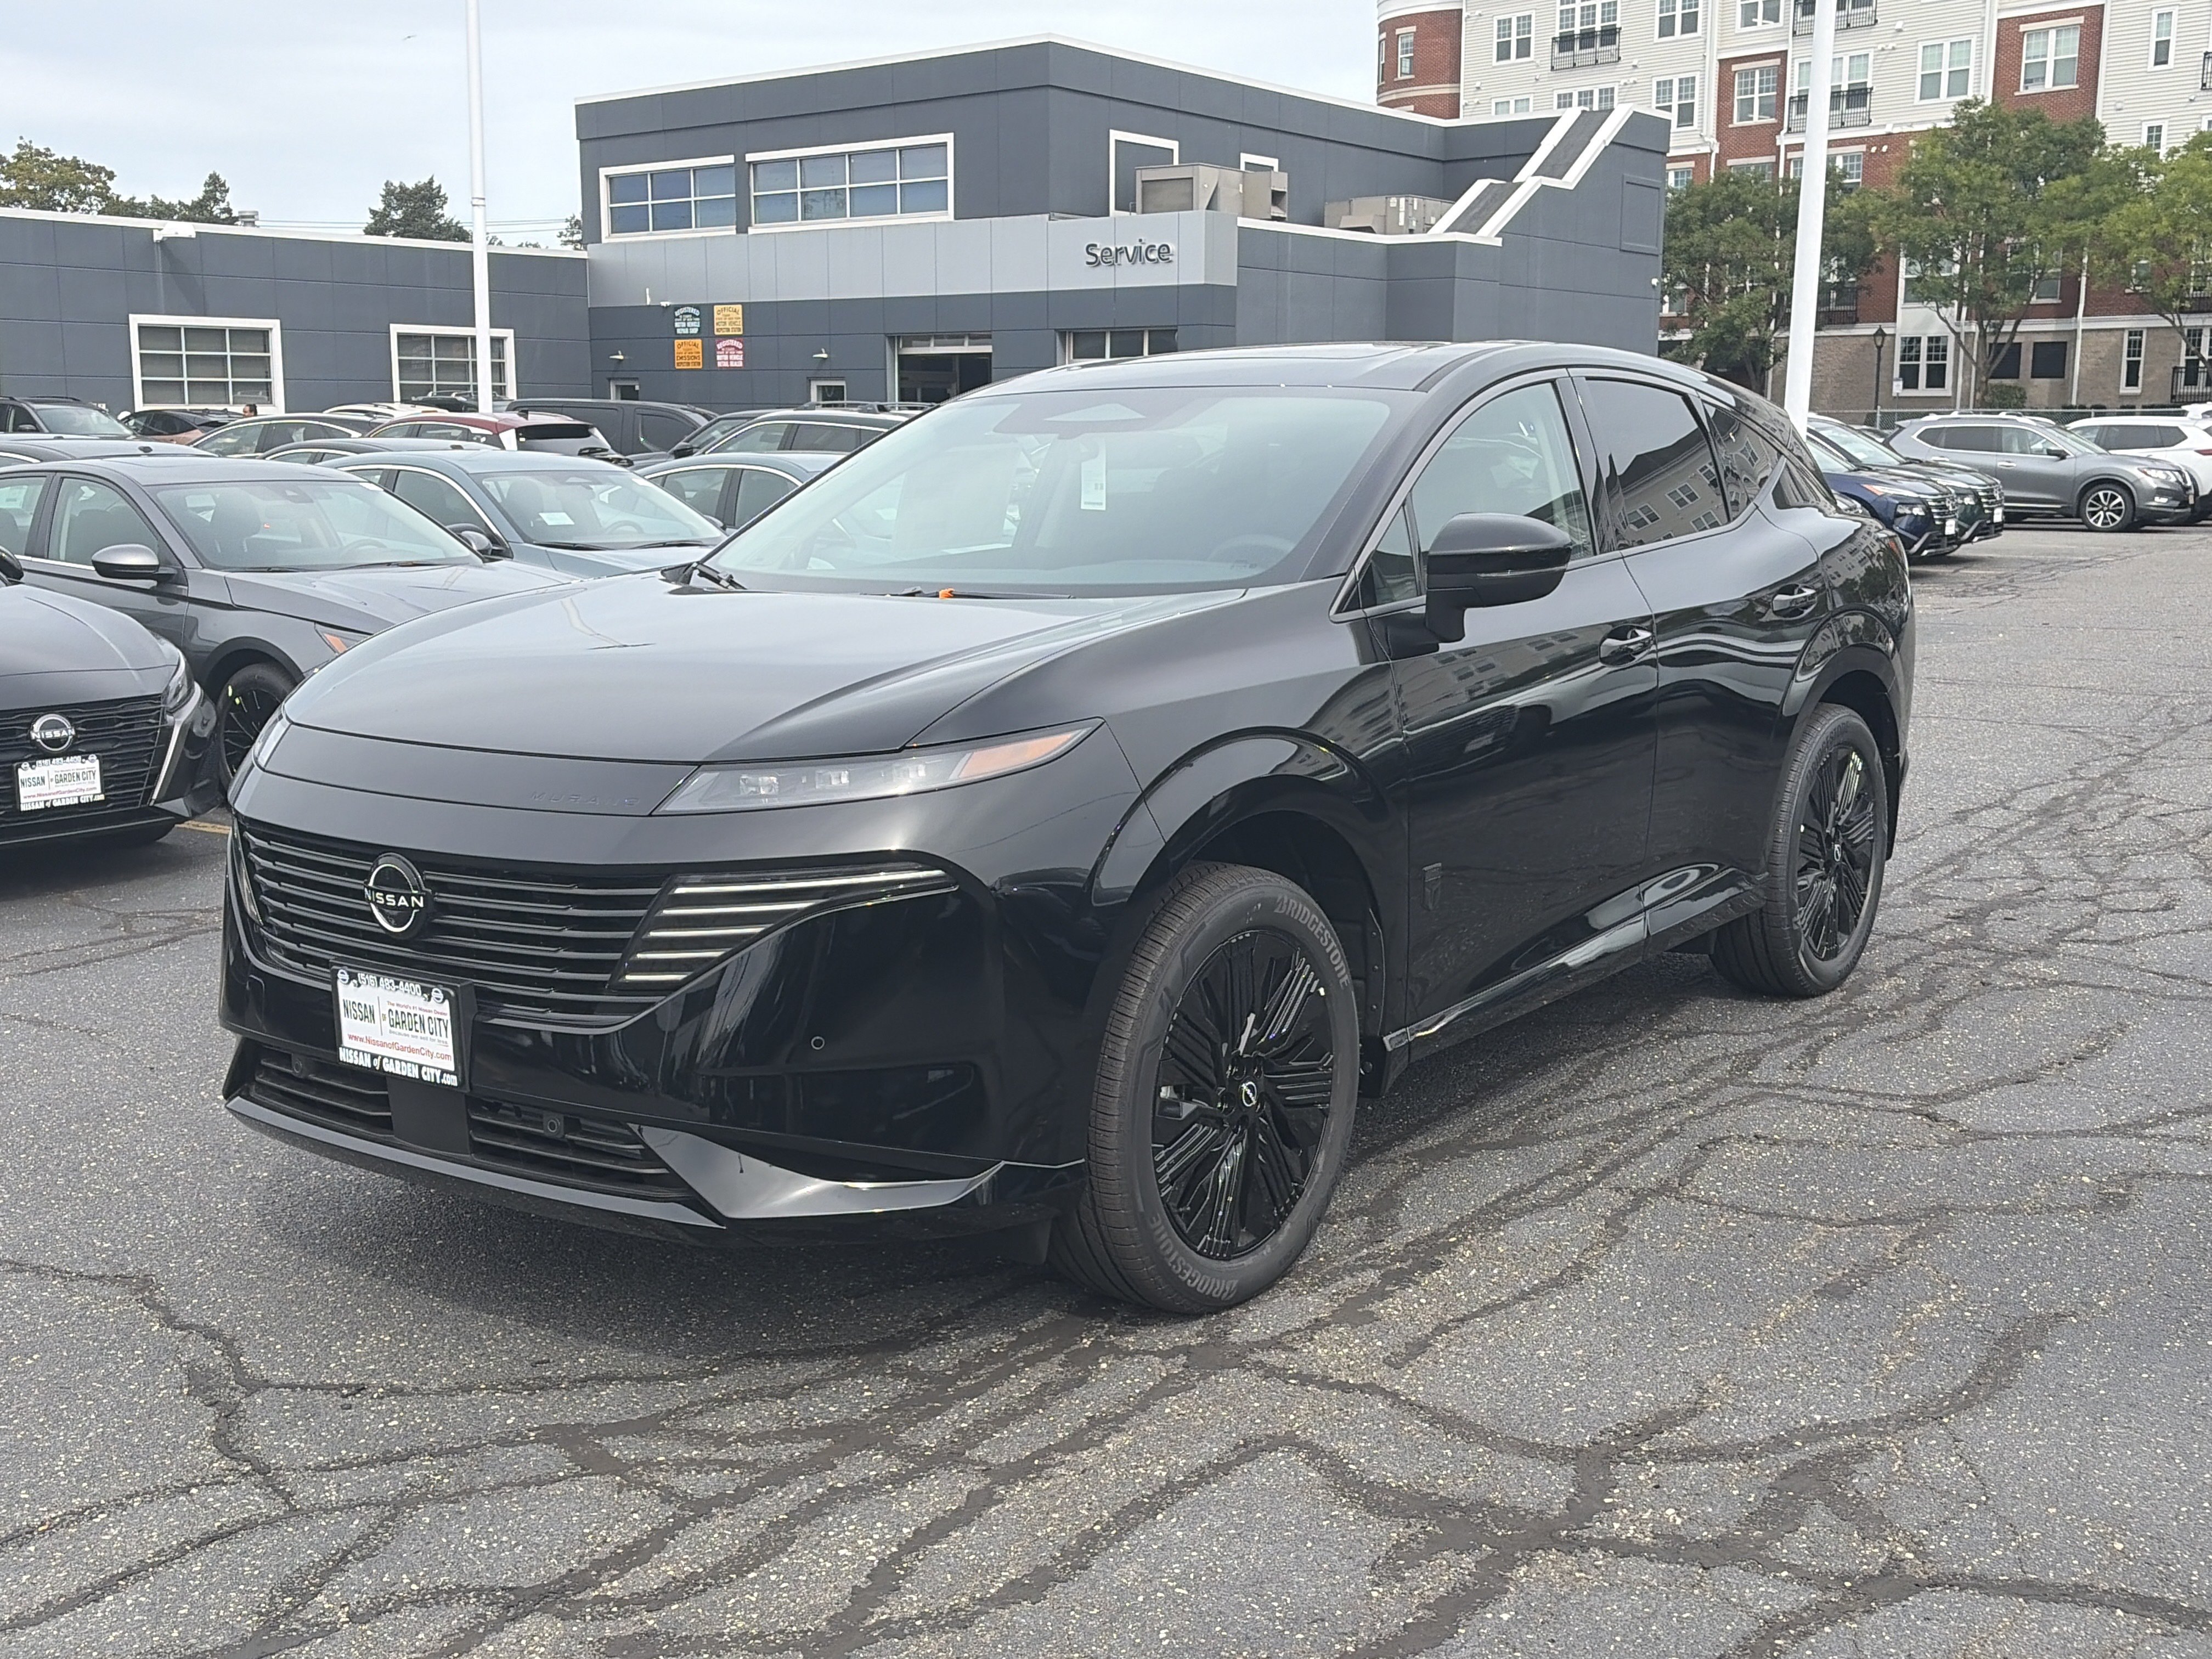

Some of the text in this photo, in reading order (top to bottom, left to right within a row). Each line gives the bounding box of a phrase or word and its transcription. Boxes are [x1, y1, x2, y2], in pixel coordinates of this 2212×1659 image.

[1086, 239, 1171, 266] Service
[716, 307, 740, 315] OFFICIAL
[677, 341, 699, 349] OFFICIAL
[31, 729, 75, 740] NISSAN
[20, 776, 46, 788] NISSAN
[54, 771, 80, 784] GARDEN
[82, 770, 97, 781] CITY
[20, 800, 44, 811] NISSAN
[53, 796, 78, 806] GARDEN
[364, 887, 424, 908] NISSAN
[1274, 894, 1351, 990] BRIDGESTONE
[358, 973, 422, 996] (516) 483-4400
[343, 998, 375, 1024] NISSAN
[388, 1008, 426, 1034] GARDEN
[427, 1016, 449, 1039] CITY
[347, 1033, 452, 1062] www.NissanofGardenCity.com
[339, 1047, 371, 1068] NISSAN
[373, 1056, 382, 1070] of
[383, 1058, 420, 1079] GARDEN
[1151, 1212, 1239, 1301] BRIDGESTONE
